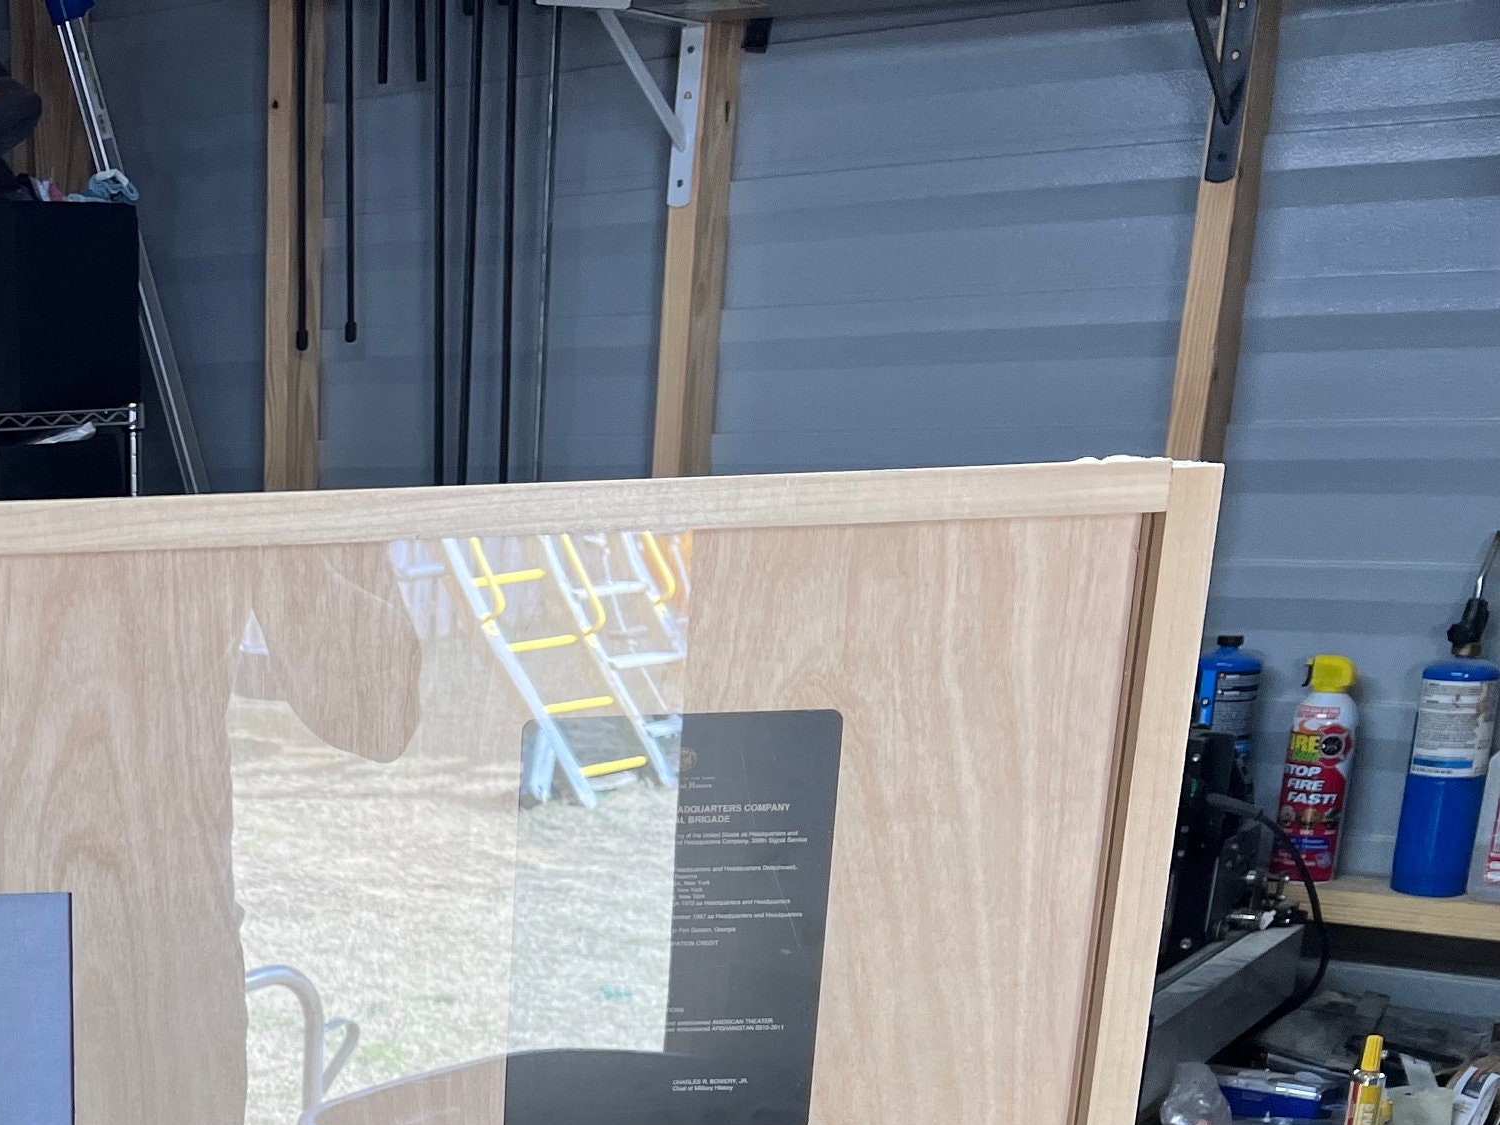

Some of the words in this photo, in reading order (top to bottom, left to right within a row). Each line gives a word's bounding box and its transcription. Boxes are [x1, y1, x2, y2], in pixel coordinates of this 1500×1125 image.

[1290, 733, 1321, 753] IRE
[1288, 764, 1322, 777] TOP
[1287, 778, 1325, 791] FIRE
[1287, 791, 1338, 805] FAST!
[677, 804, 742, 813] ADQUARTERS
[743, 803, 790, 812] COMPANY
[688, 815, 731, 824] BRIGADE
